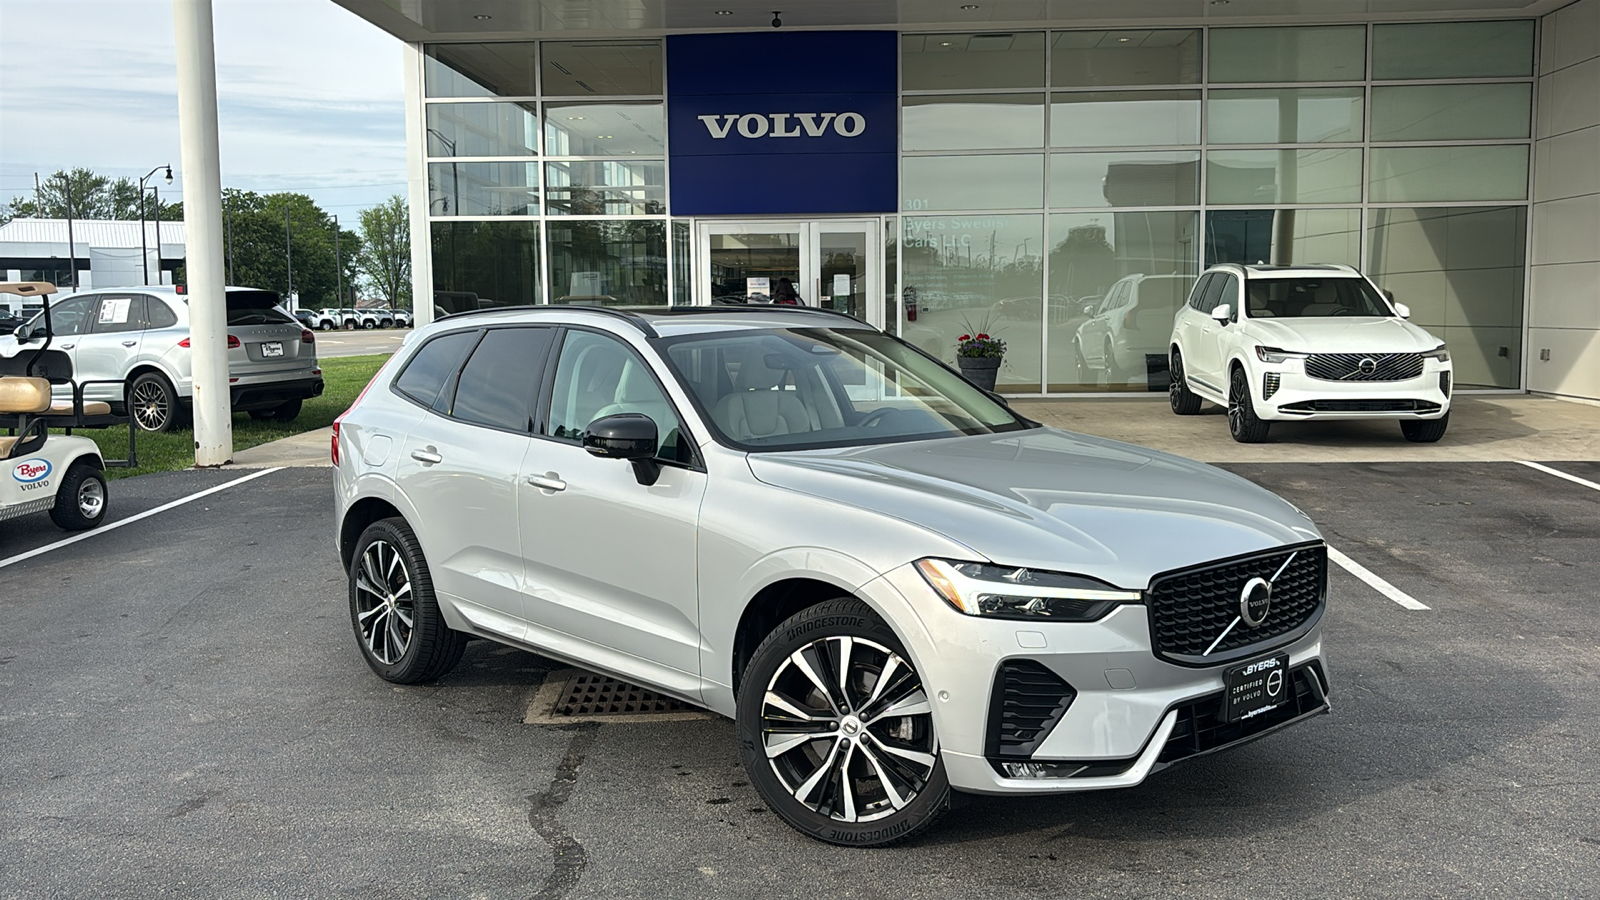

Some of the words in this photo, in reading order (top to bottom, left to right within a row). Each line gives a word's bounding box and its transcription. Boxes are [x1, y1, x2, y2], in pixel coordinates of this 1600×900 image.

[697, 112, 866, 139] VOLVO
[904, 199, 929, 210] 301
[904, 218, 946, 233] Byers
[951, 217, 1013, 230] Swedish
[904, 235, 938, 248] Cars
[943, 234, 972, 247] LLC
[17, 464, 47, 477] Byers
[20, 480, 50, 492] VOLVO
[786, 616, 865, 642] BRIDGESTONE
[1246, 658, 1276, 675] BYERS
[1232, 679, 1263, 694] CERTIFIED
[1233, 697, 1241, 705] BY
[1242, 690, 1261, 701] VOLVO
[830, 819, 912, 843] BRIDGESTONE
